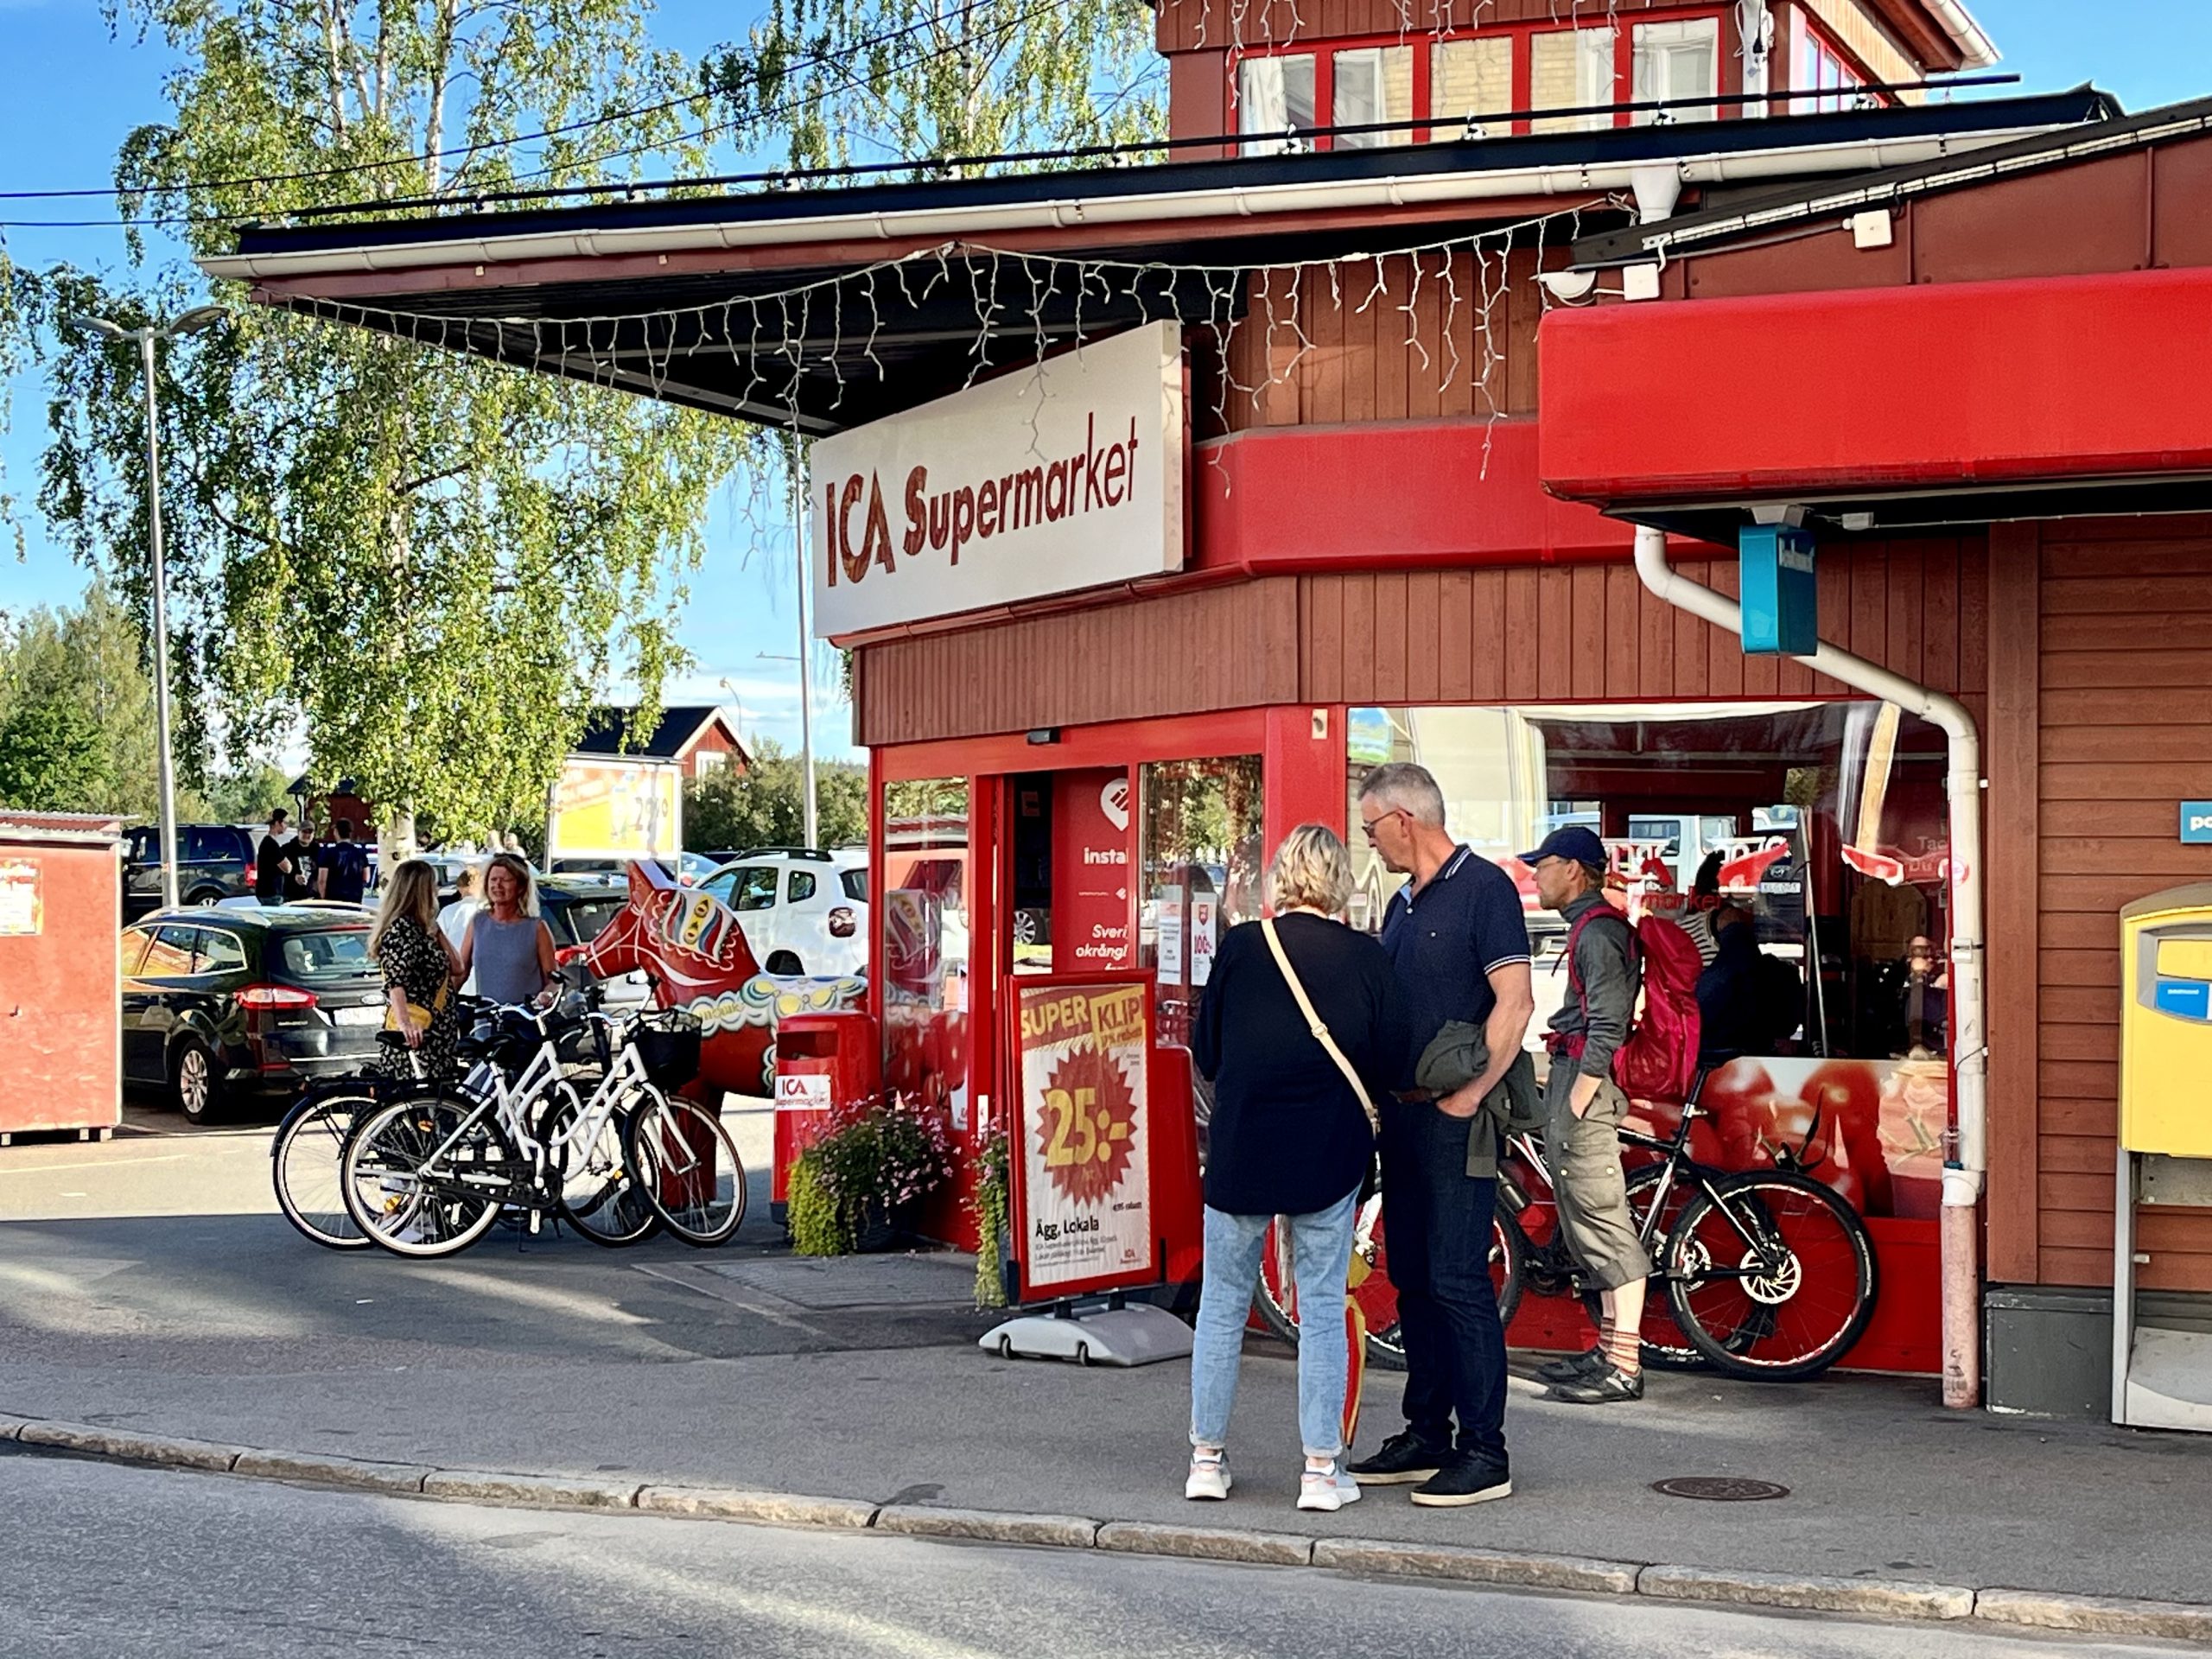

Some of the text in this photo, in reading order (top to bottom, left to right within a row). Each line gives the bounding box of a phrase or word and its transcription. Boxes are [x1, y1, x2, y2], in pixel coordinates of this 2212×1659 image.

[826, 411, 1138, 588] ICA Supermarket
[1020, 995, 1089, 1040] SUPER
[782, 1077, 808, 1096] ICA
[1046, 1088, 1128, 1167] 25:-
[1064, 1215, 1099, 1234] Lokala
